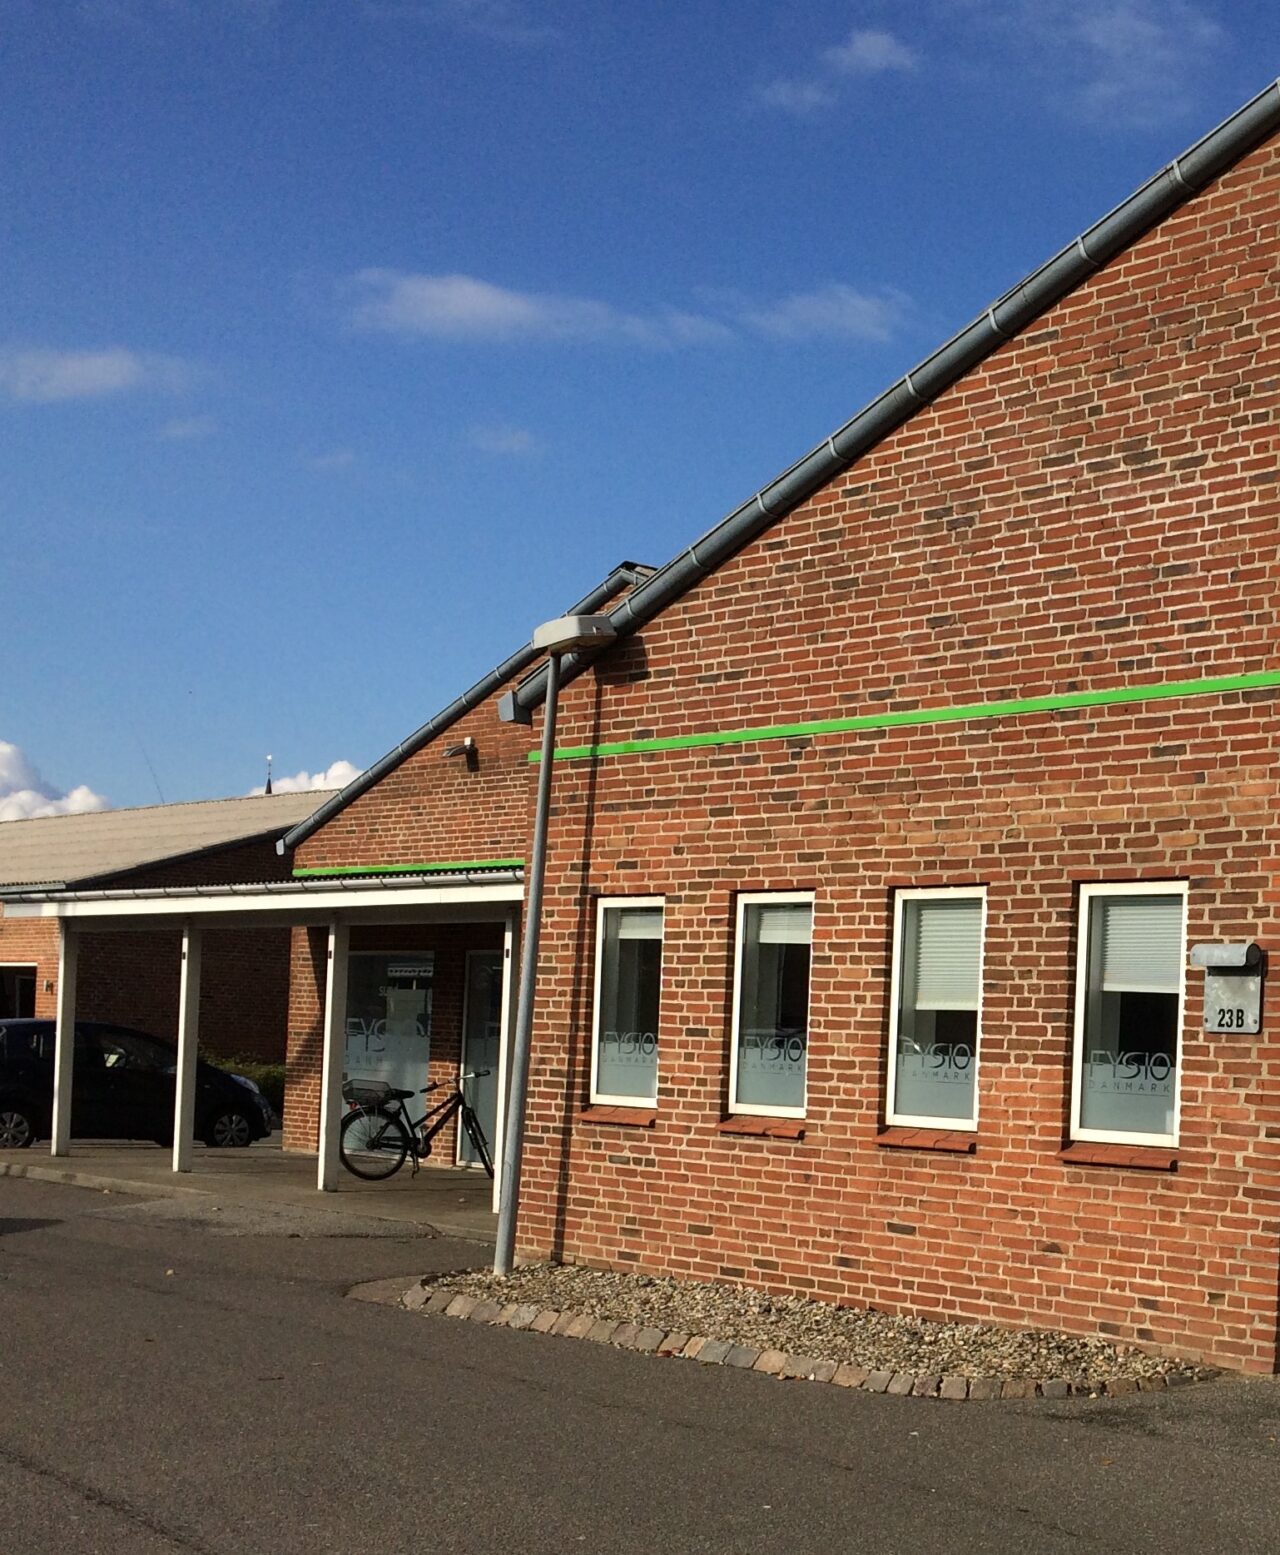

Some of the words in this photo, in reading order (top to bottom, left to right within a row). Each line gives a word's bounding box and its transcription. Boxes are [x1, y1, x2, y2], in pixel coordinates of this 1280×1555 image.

[743, 1036, 803, 1062] FYSIO
[902, 1042, 971, 1070] FYSIO
[1089, 1050, 1171, 1081] FYSIO
[1088, 1079, 1171, 1093] DANMARK
